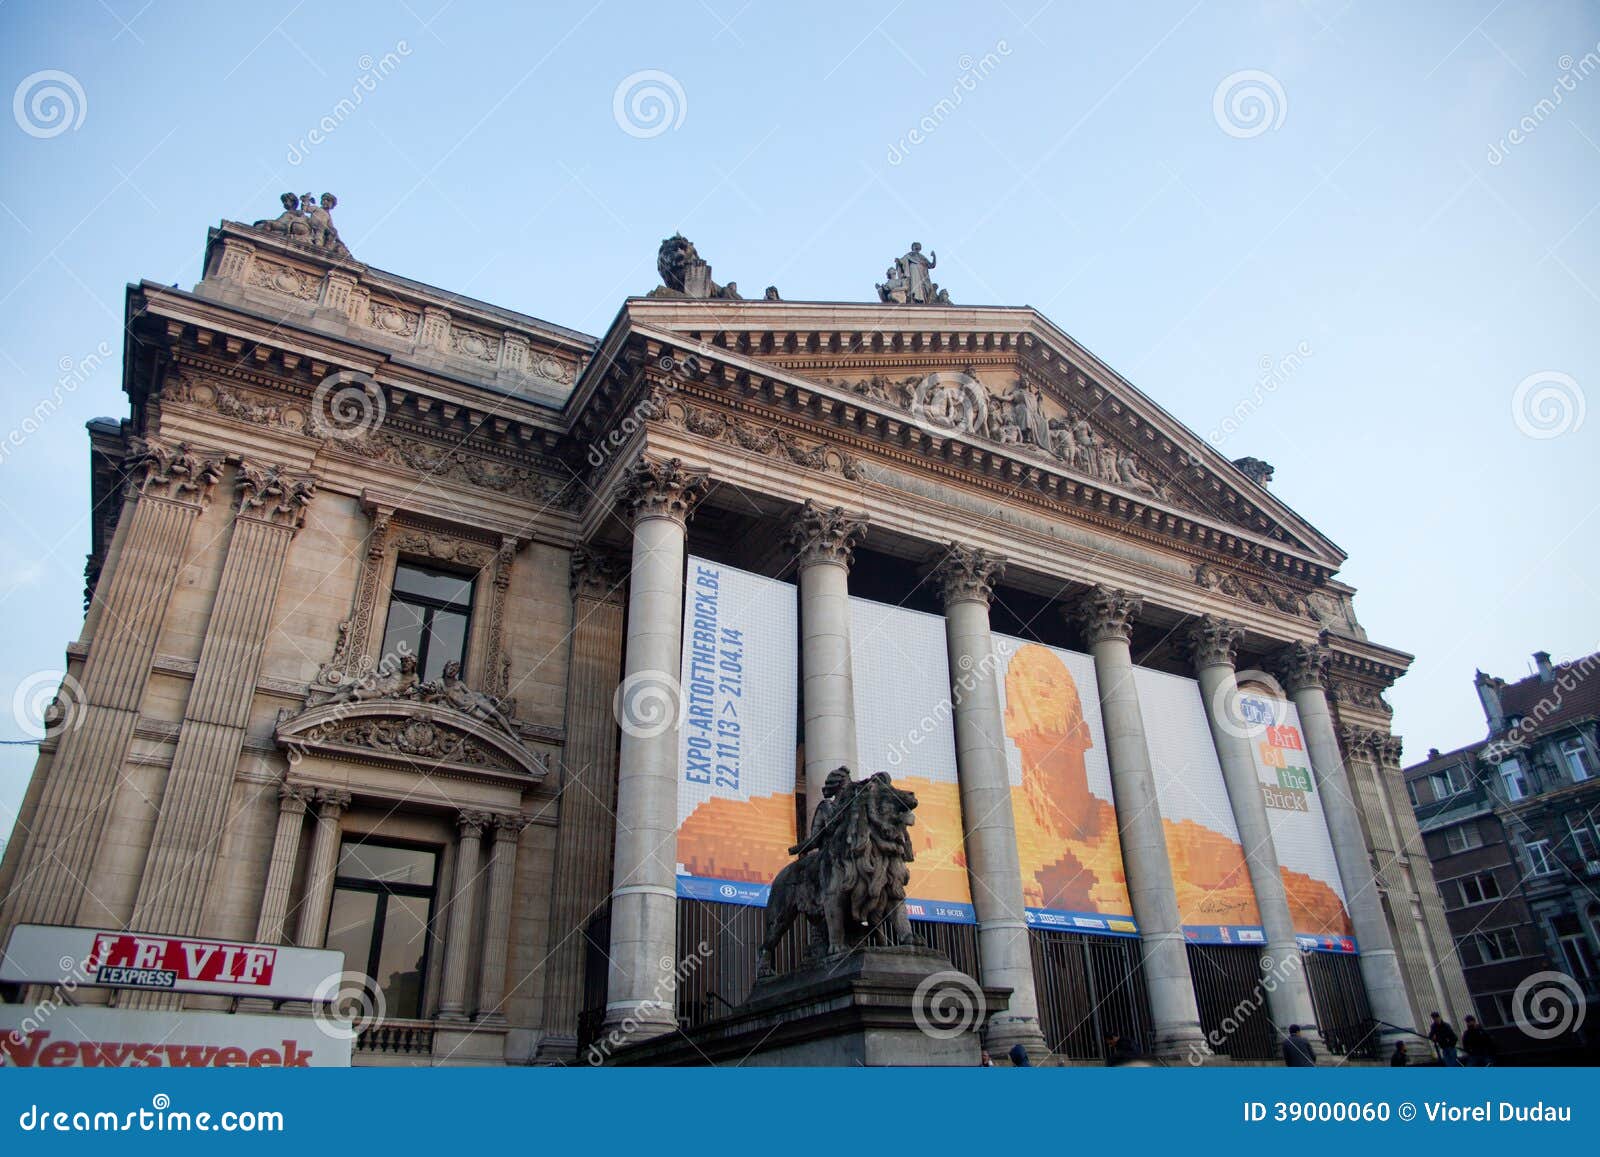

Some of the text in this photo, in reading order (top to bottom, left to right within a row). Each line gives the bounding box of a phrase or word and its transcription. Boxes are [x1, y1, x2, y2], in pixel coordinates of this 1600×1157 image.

[719, 627, 744, 698] 21.04.14
[686, 565, 720, 786] EXPO-ARTOFTHEBRICK.BE
[1241, 702, 1273, 725] The
[1274, 727, 1298, 748] Art
[715, 722, 741, 791] 22.11.13
[1264, 749, 1281, 766] of
[1282, 770, 1309, 791] the
[1262, 788, 1306, 812] Brick
[97, 935, 274, 983] LE VIF
[99, 968, 173, 987] L'EXPRESS
